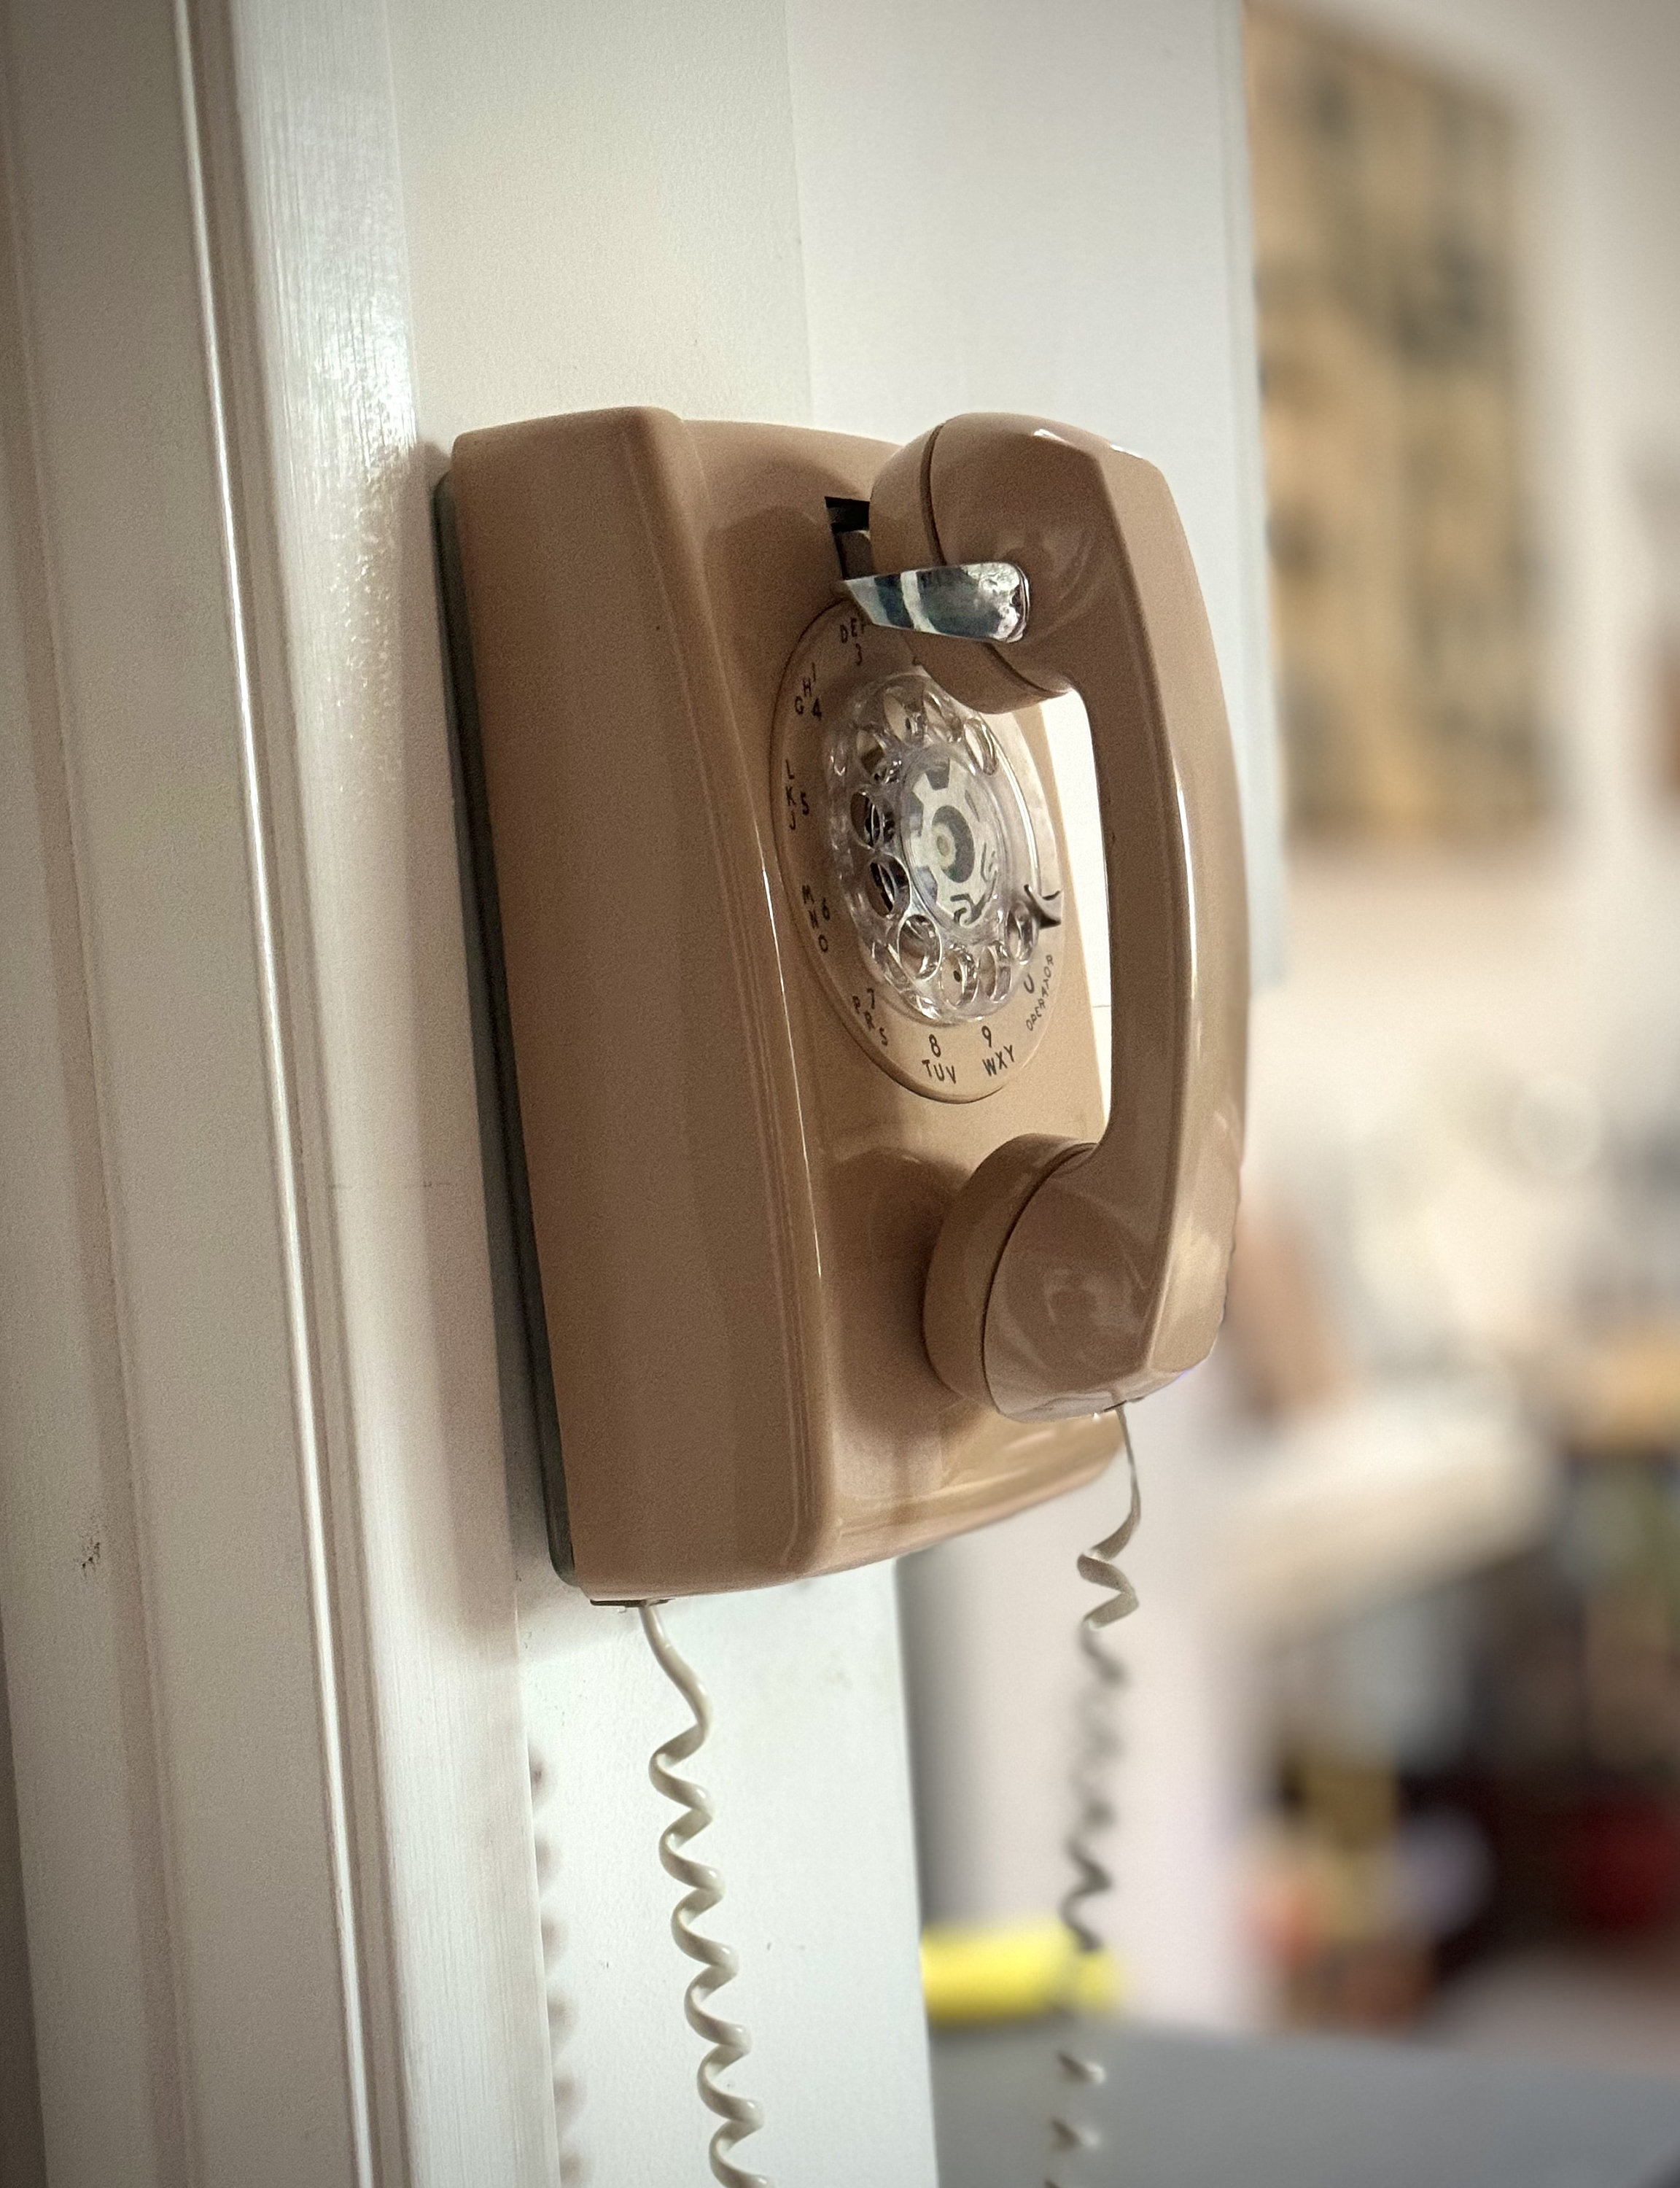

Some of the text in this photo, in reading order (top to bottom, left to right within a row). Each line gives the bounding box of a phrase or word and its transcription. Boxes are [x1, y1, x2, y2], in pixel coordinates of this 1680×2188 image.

[855, 643, 863, 666] 3
[812, 697, 822, 721] 4
[800, 791, 810, 815] 5
[822, 897, 831, 921] 6
[866, 988, 875, 1009] 7
[1025, 954, 1054, 1032] OPERATOR
[852, 996, 888, 1047] PRS
[928, 1033, 941, 1058] 8
[981, 1025, 992, 1048] 9
[921, 1059, 957, 1085] TUV
[981, 1044, 1015, 1077] WXY
